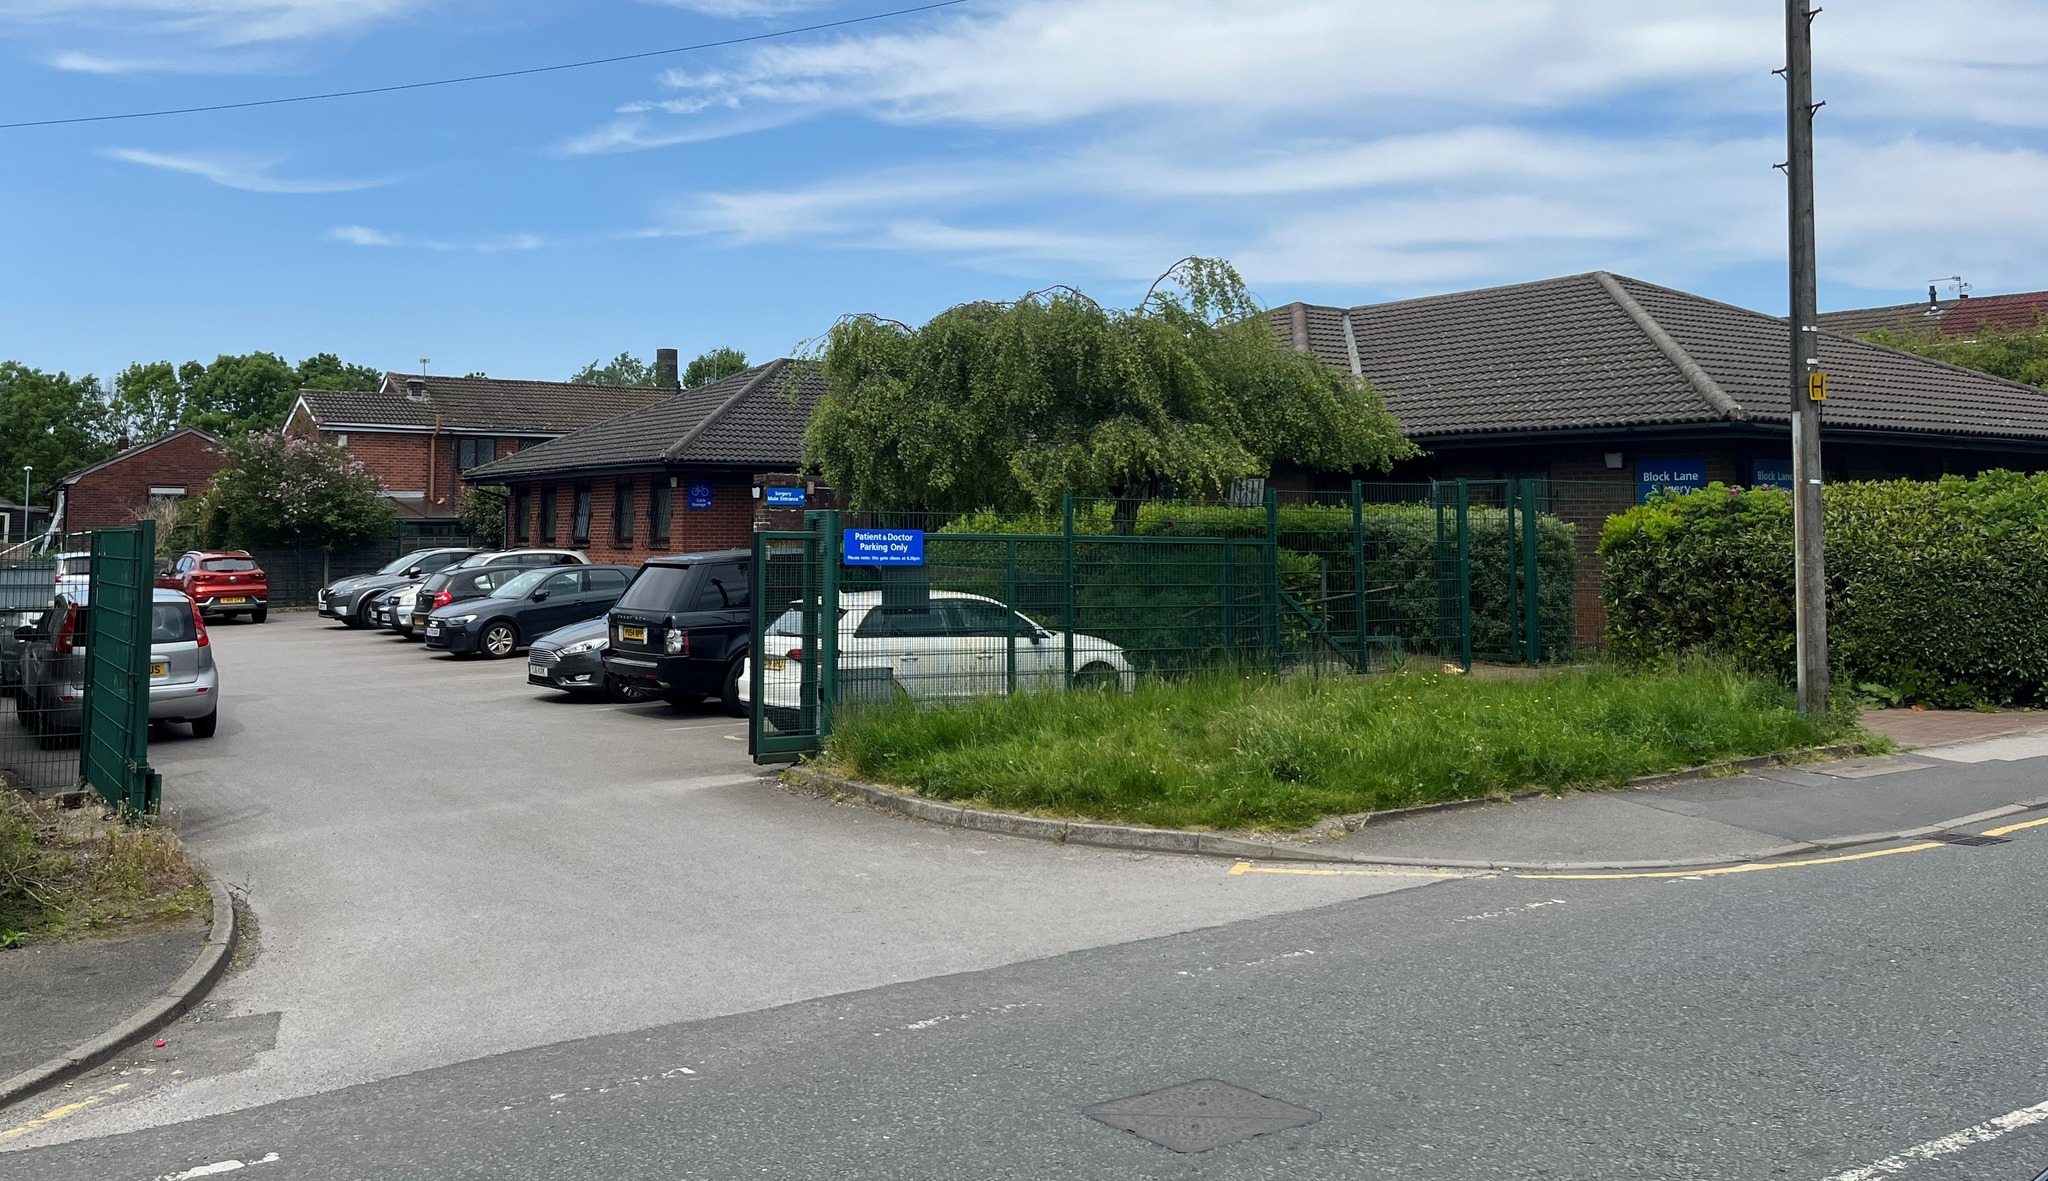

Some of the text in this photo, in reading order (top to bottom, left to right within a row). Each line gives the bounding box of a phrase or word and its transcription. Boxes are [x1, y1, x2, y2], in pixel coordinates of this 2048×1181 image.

[1811, 375, 1824, 397] H
[1643, 471, 1699, 482] Block Lane
[1757, 471, 1776, 481] Block
[1651, 484, 1691, 496] Sery
[855, 532, 881, 541] Patient
[887, 533, 913, 541] Doctor
[860, 543, 908, 553] Parking Only
